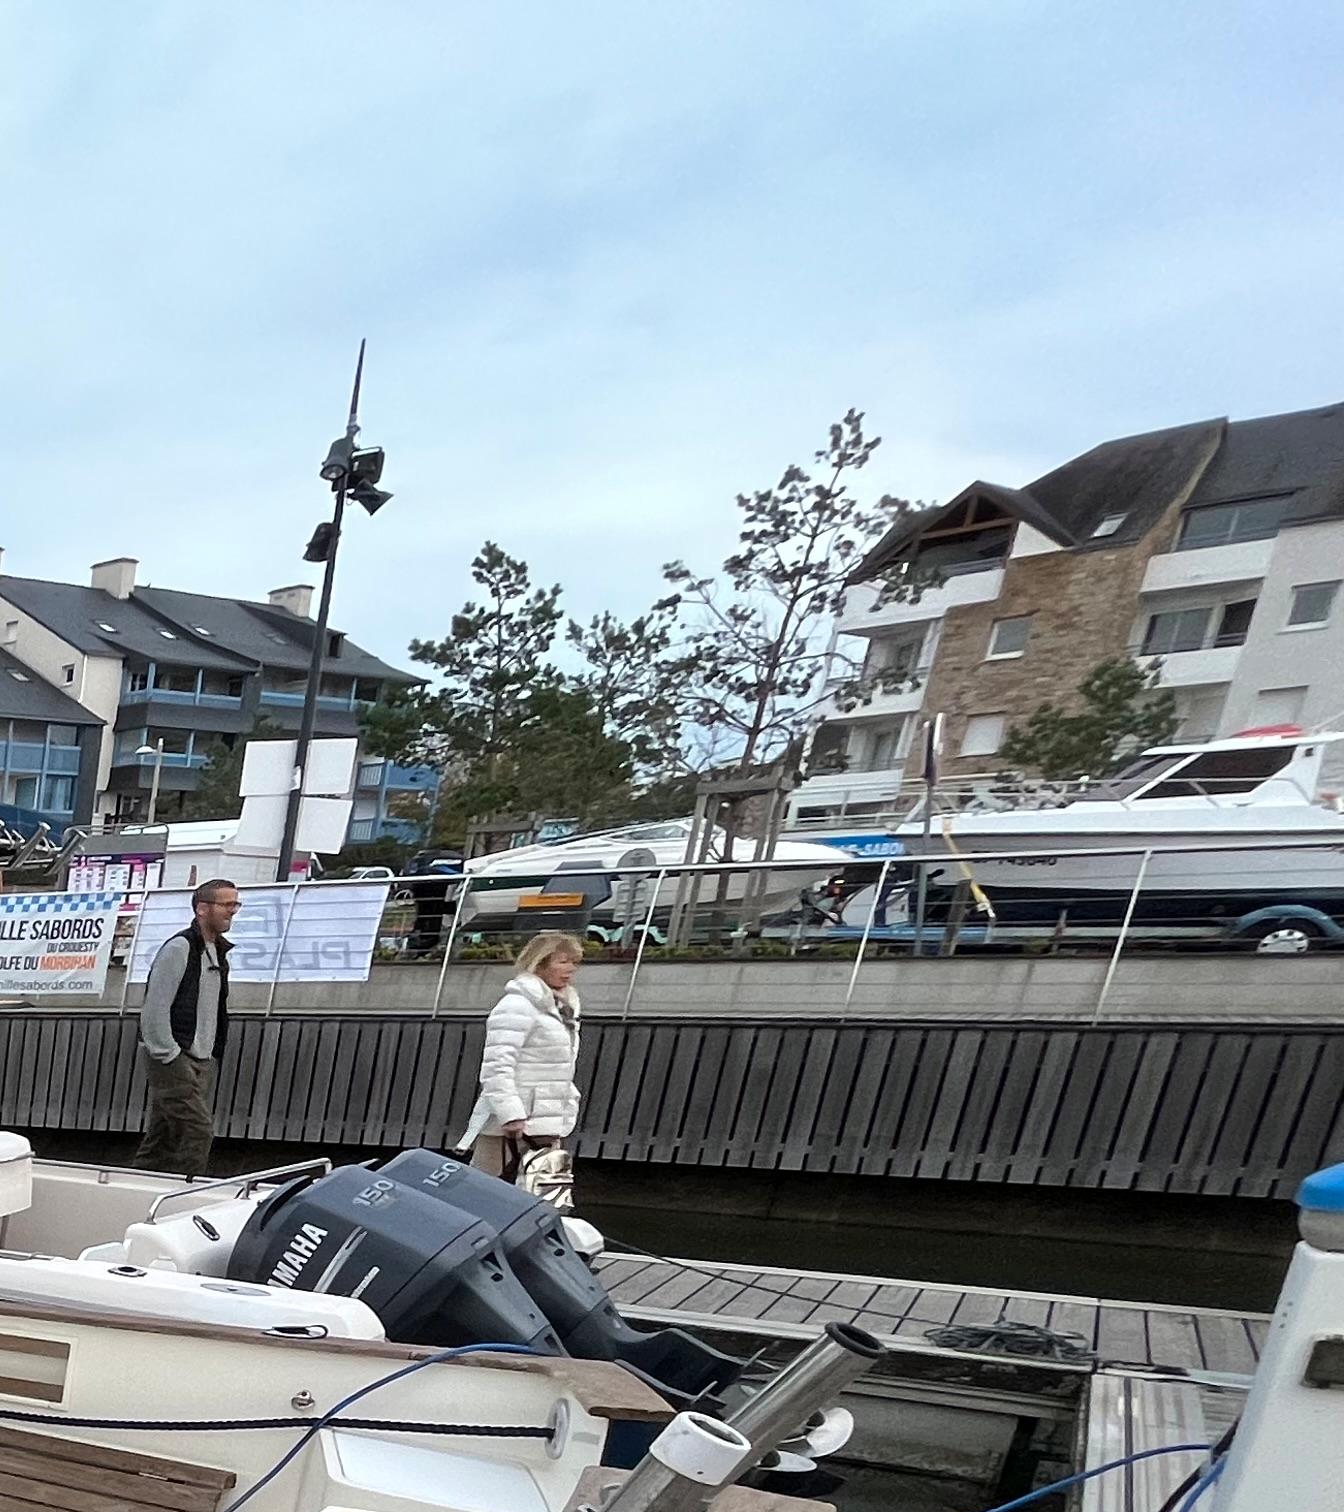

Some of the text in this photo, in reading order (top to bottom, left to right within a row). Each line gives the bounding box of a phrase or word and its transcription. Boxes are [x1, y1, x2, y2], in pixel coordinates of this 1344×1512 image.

[30, 918, 104, 940] SABORDS
[23, 956, 40, 970] DU
[39, 955, 96, 971] MORBIHAN
[422, 1162, 461, 1187] 150
[353, 1180, 393, 1207] 150
[267, 1223, 329, 1289] MAHA
